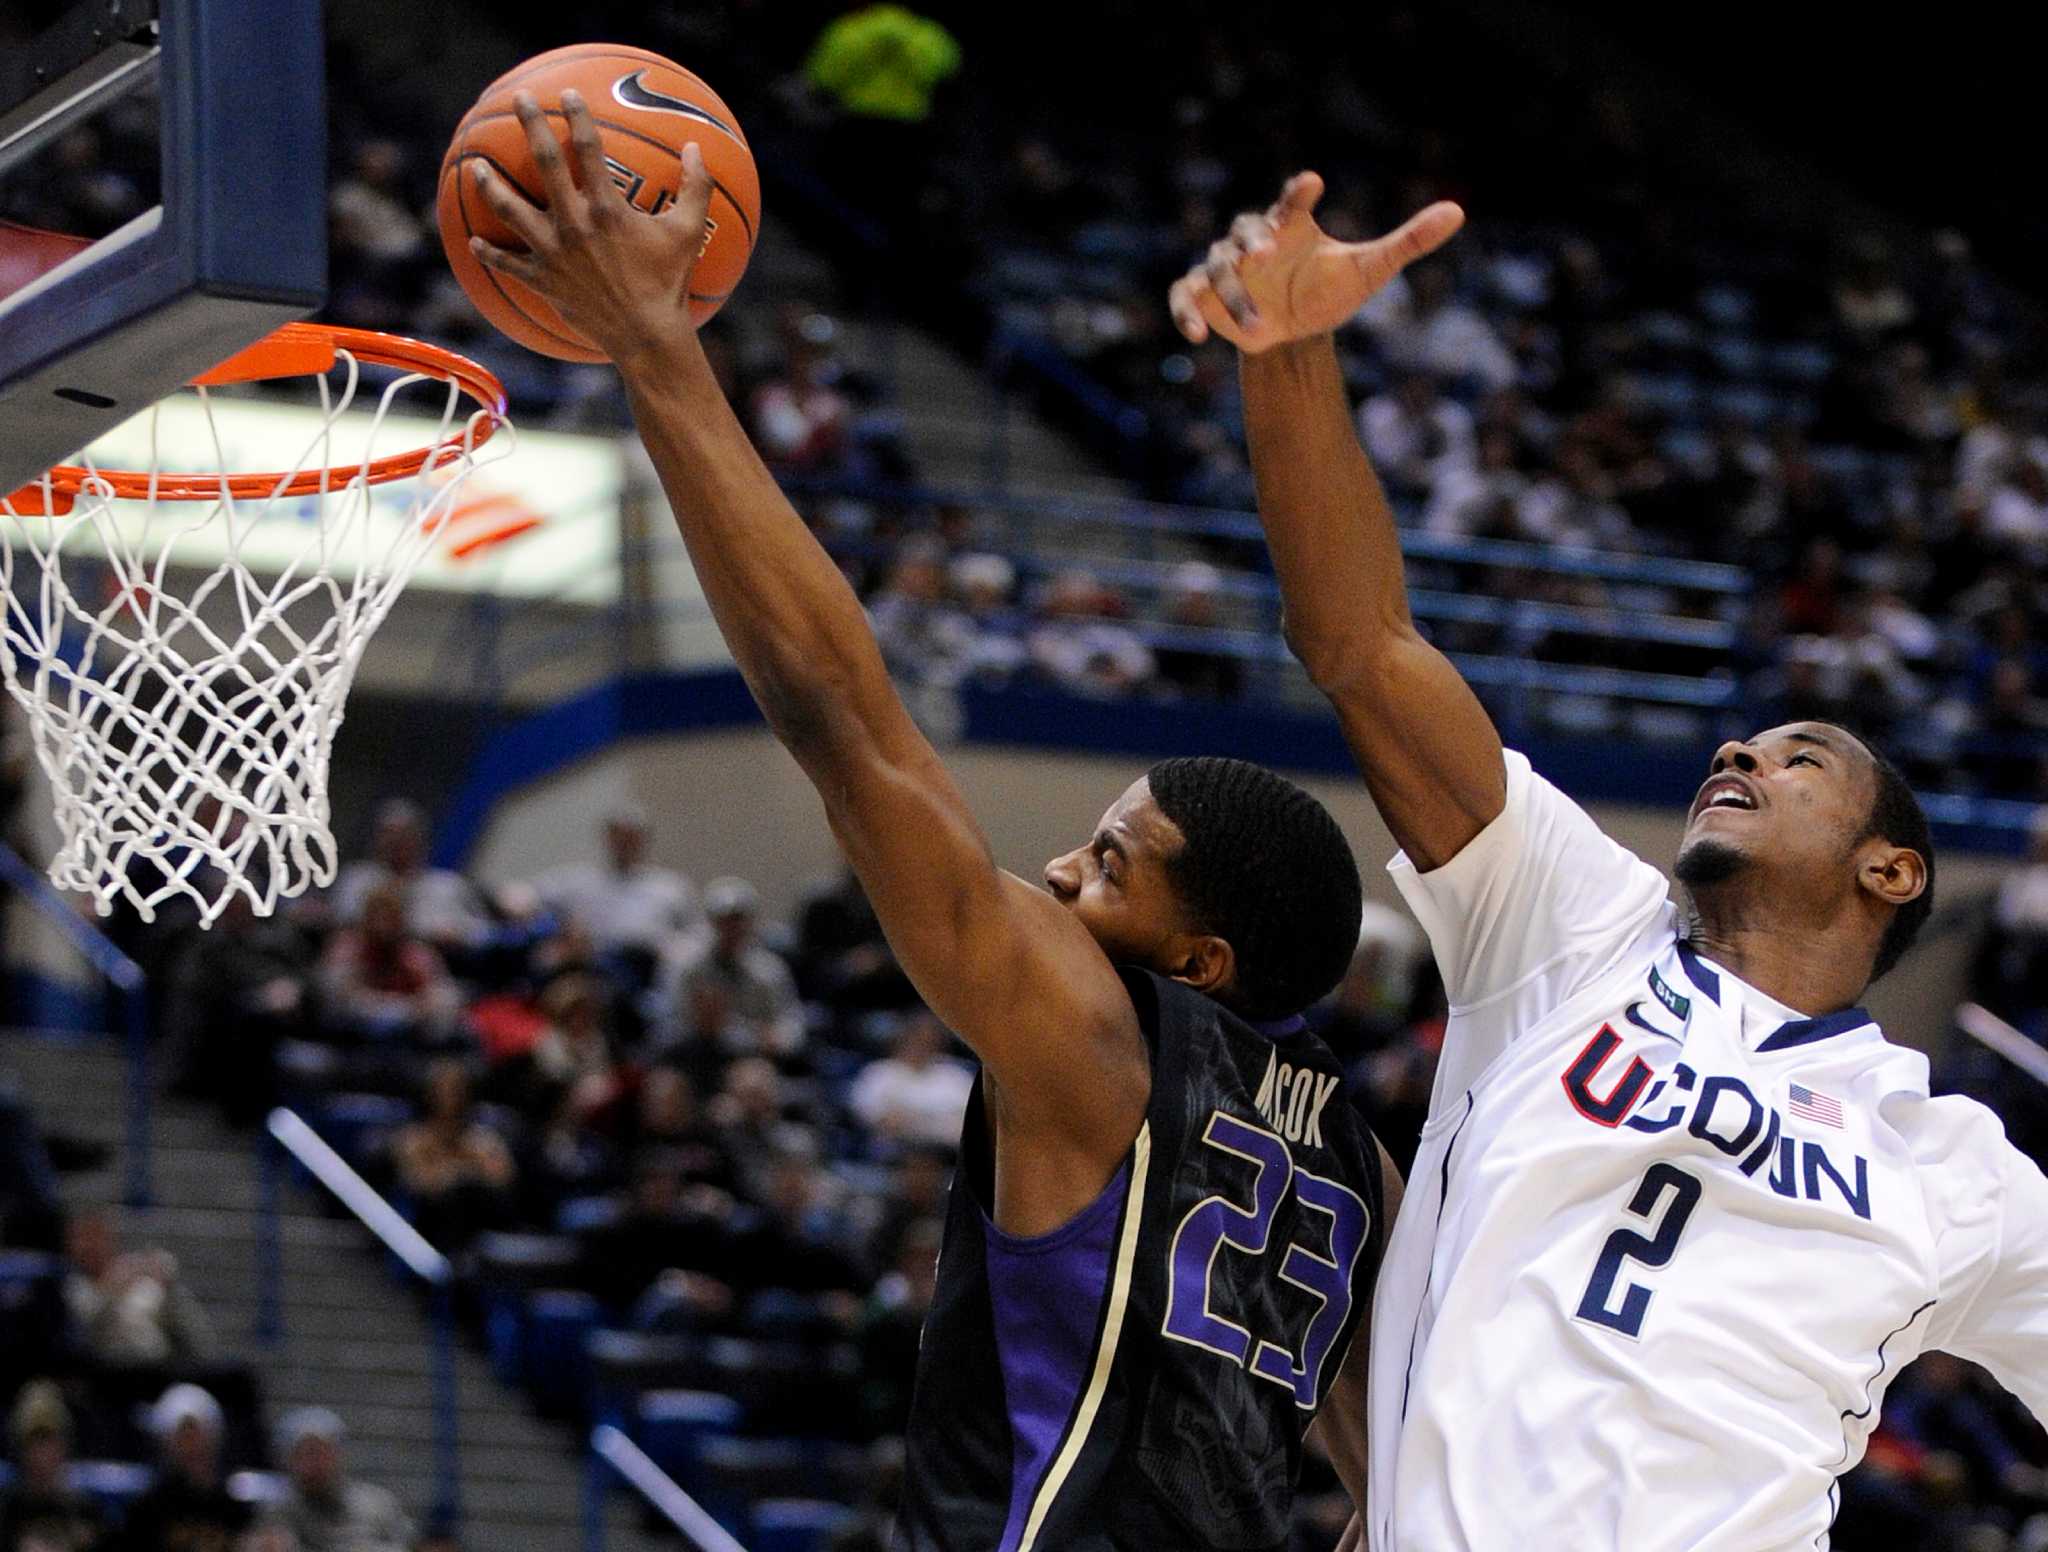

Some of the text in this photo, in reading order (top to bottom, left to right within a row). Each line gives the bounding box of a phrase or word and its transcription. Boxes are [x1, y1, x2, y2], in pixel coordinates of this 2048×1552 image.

[1561, 1022, 1871, 1221] UCONN
[1162, 1110, 1370, 1410] 23
[1572, 1161, 1704, 1341] 2
